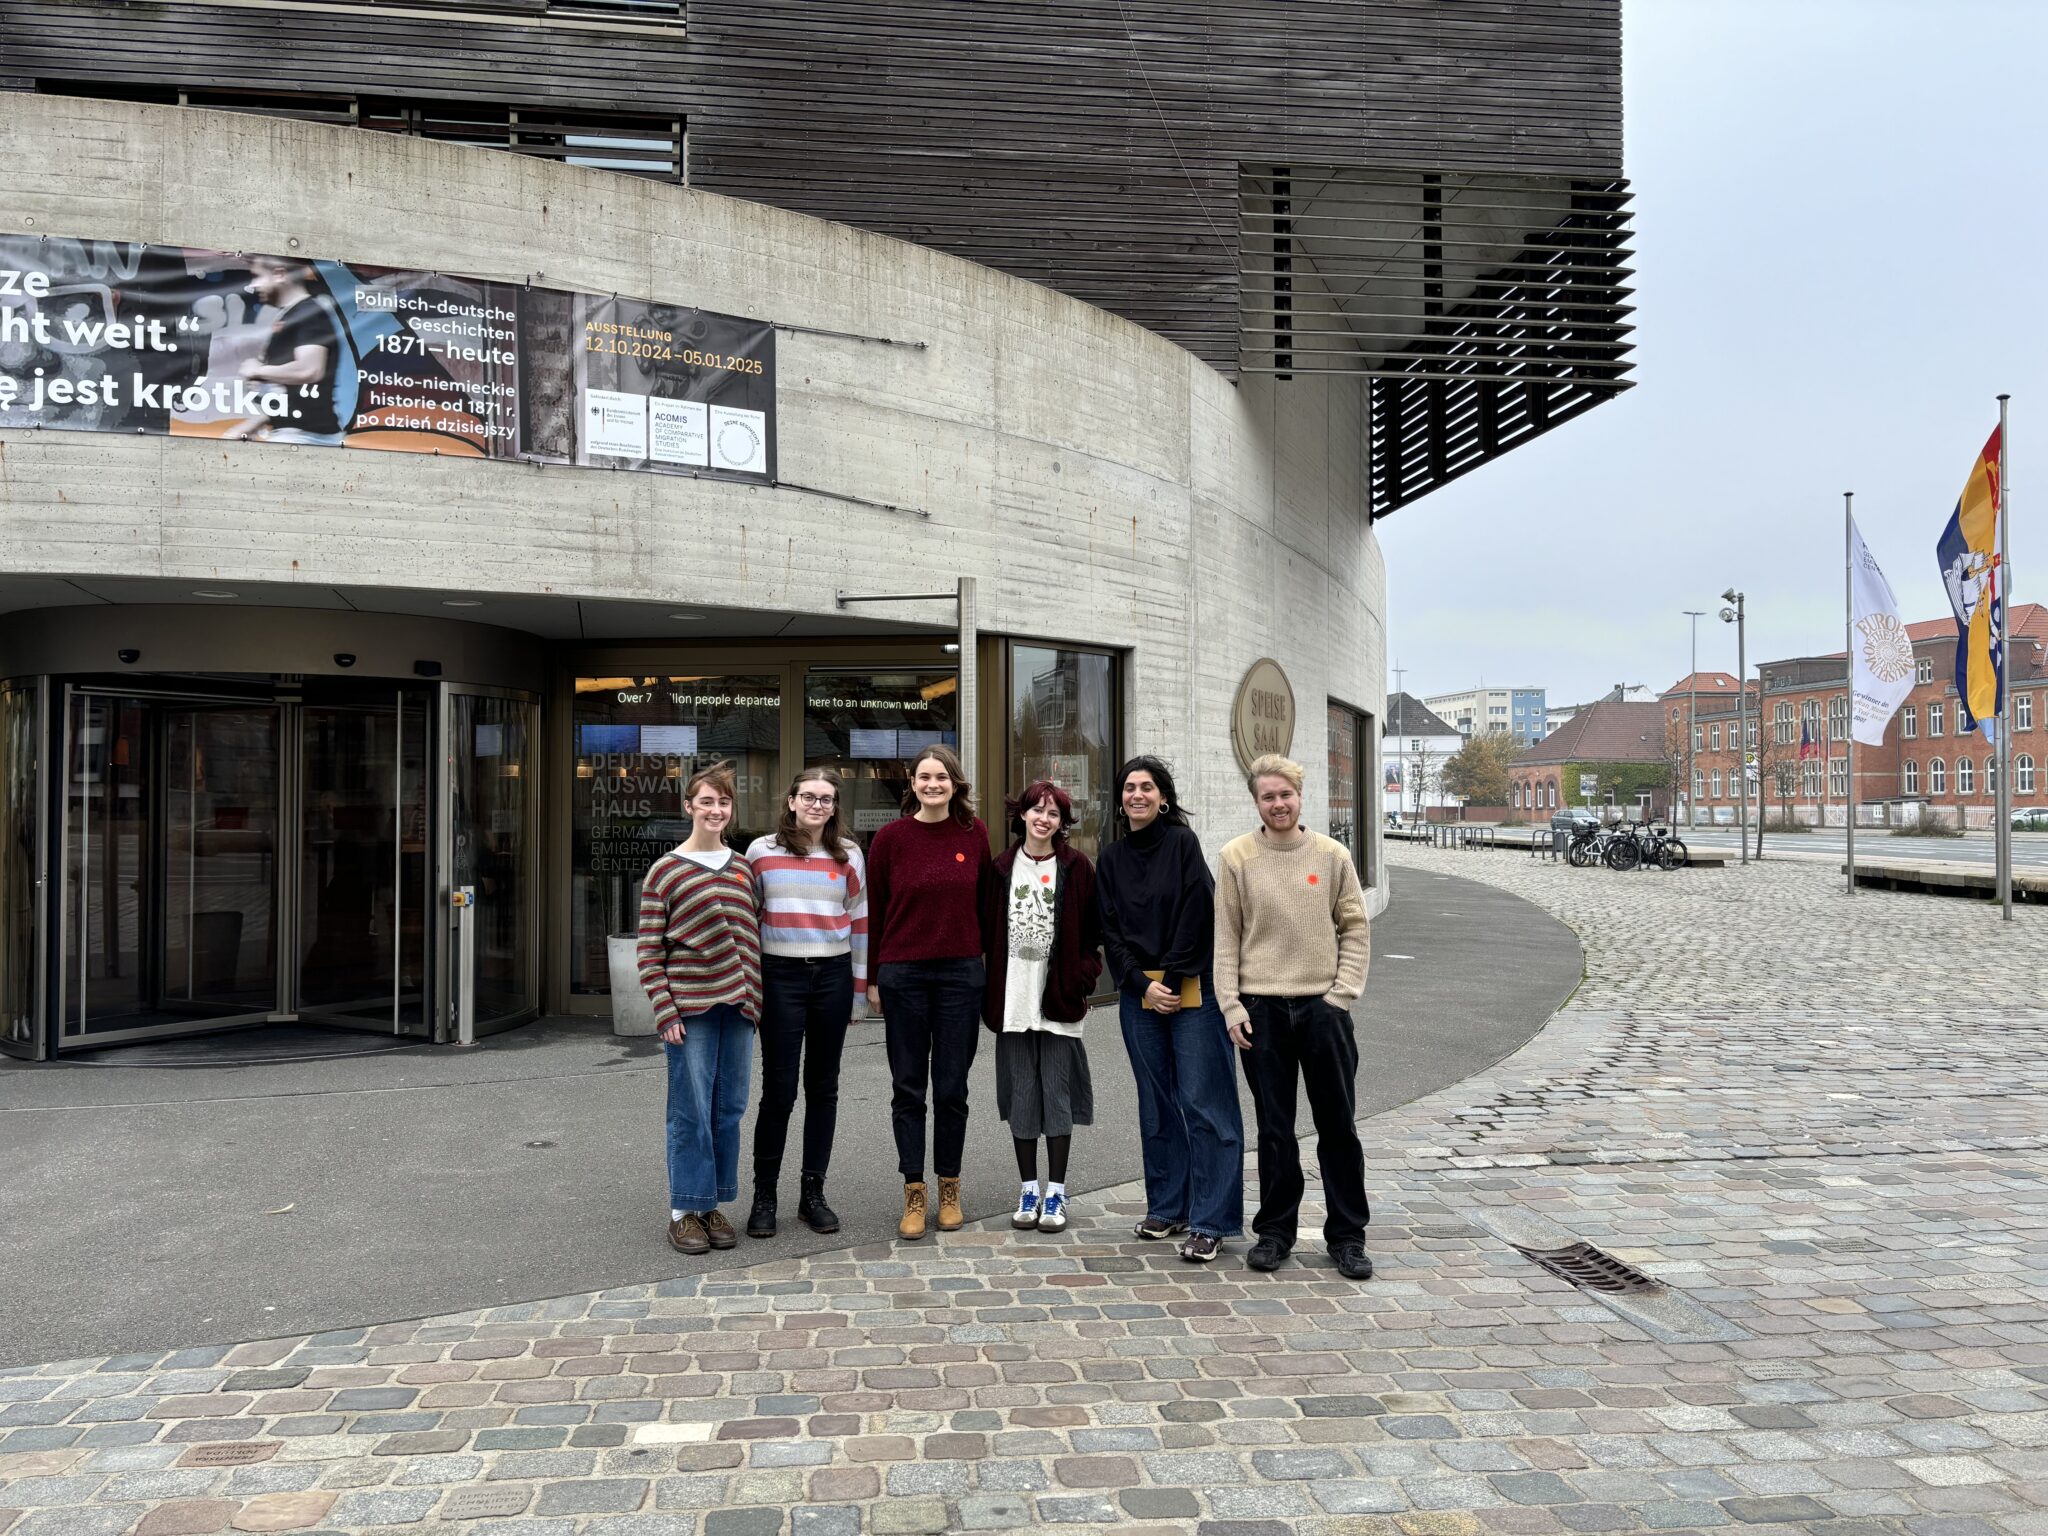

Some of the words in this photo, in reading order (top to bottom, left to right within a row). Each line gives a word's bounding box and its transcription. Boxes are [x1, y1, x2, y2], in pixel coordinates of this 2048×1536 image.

[355, 290, 515, 322] Polnisch-deutsche
[408, 316, 515, 341] Geschichten
[585, 321, 672, 342] AUSSTELLUNG
[29, 367, 118, 411] jest
[357, 369, 515, 397] Polsko-niemieckie
[370, 390, 436, 410] historie
[442, 398, 463, 412] od
[468, 401, 501, 416] 1871
[506, 406, 516, 417] r.
[356, 414, 379, 428] po
[385, 413, 431, 430] dzień
[436, 418, 515, 440] dzisiejszy
[655, 412, 688, 424] ACOMIS
[617, 692, 643, 704] Over
[646, 692, 652, 703] 7
[695, 693, 731, 707] people
[734, 693, 780, 708] departed
[809, 697, 830, 707] here
[833, 697, 843, 707] to
[846, 699, 858, 708] an
[860, 699, 901, 709] unknown
[903, 700, 928, 710] world
[1251, 687, 1286, 722] SPEISE
[1253, 721, 1281, 753] SAAL
[591, 752, 722, 770] DEUTSCHES
[591, 775, 763, 794] AUSWANER
[591, 800, 651, 818] HAUS
[591, 825, 657, 839] GERMAN
[591, 841, 680, 855] EMIGRATIO
[591, 857, 651, 871] CENTER
